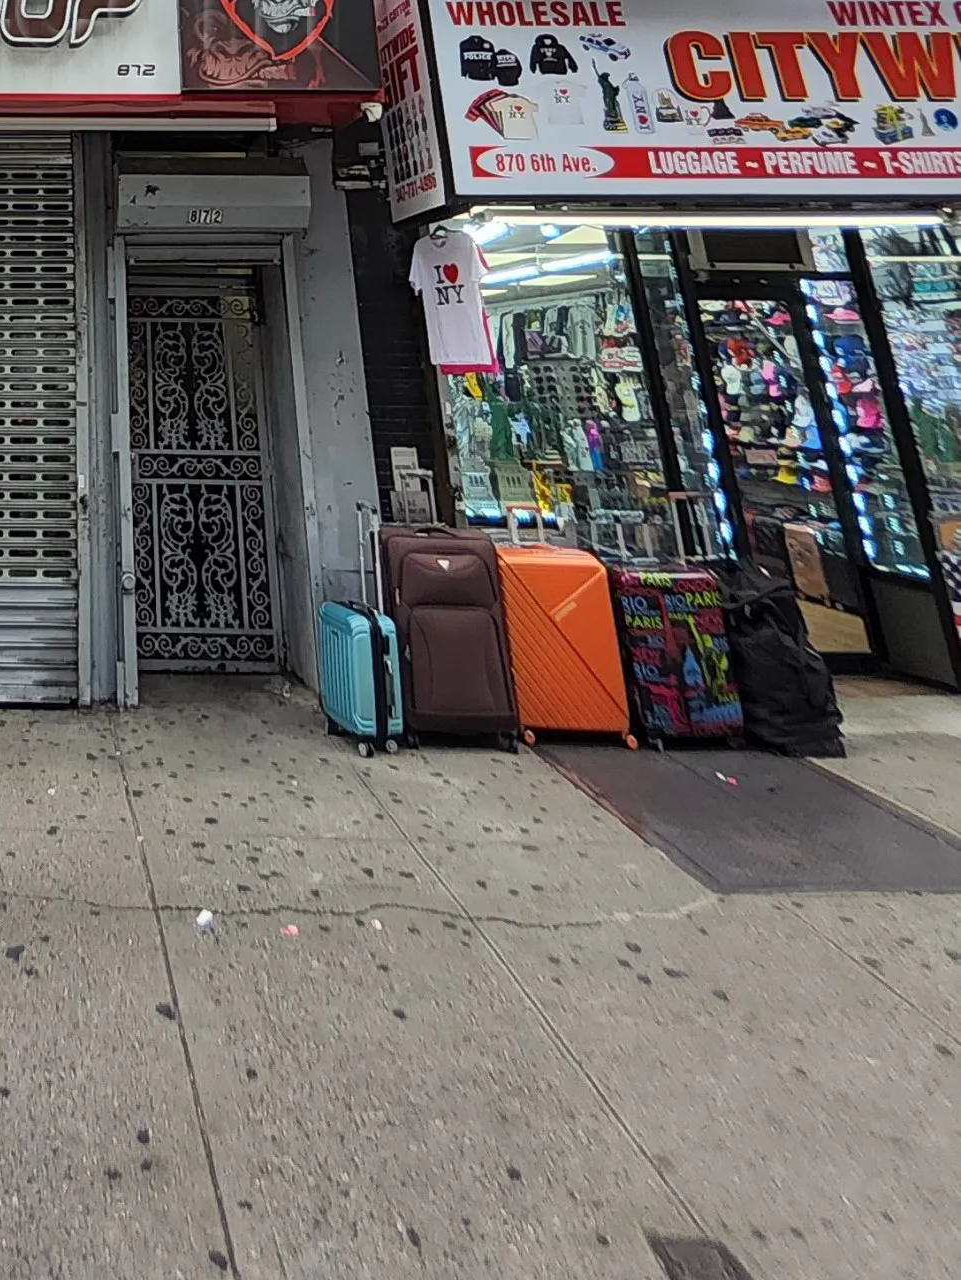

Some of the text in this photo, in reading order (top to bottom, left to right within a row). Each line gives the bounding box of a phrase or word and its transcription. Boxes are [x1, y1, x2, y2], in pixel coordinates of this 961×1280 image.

[445, 0, 627, 28] WHOLESALE
[826, 0, 950, 27] WINTEX
[117, 64, 156, 77] 872
[663, 29, 961, 102] CITYW
[495, 153, 598, 173] 870 6th Ave.
[647, 150, 741, 175] LUGGAGE
[760, 151, 861, 176] PERFUME
[190, 209, 222, 224] 872
[433, 264, 446, 285] I
[435, 283, 465, 306] NY
